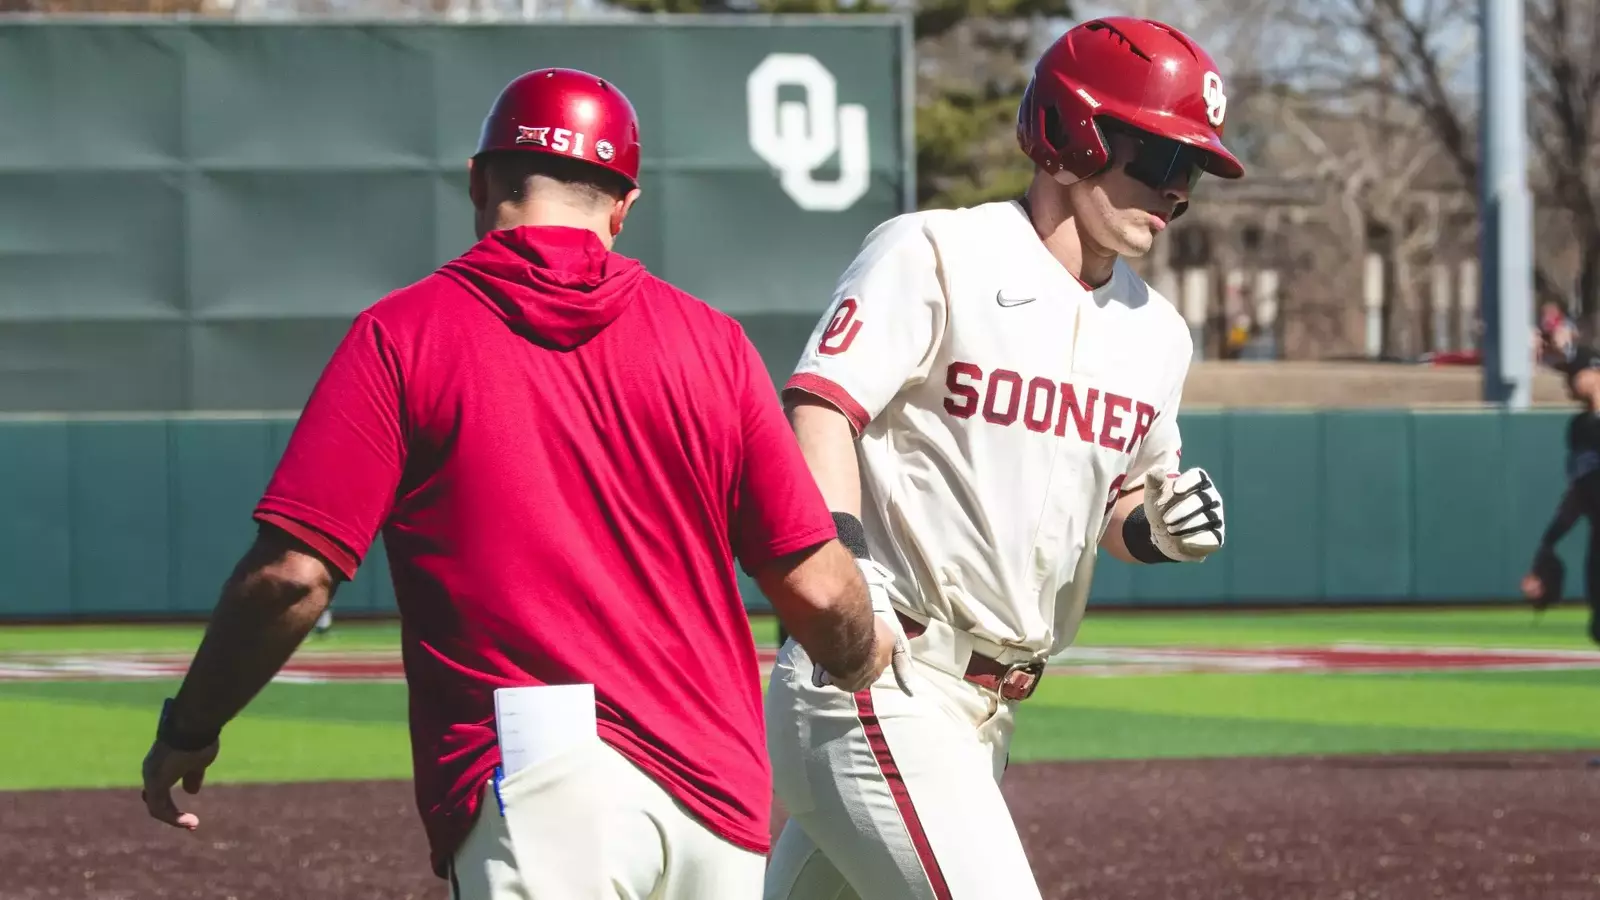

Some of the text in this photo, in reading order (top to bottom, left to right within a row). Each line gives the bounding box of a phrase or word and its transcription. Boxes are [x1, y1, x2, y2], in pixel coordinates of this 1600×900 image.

[1203, 70, 1228, 126] OU
[551, 128, 585, 158] 51
[746, 52, 871, 212] OU
[818, 298, 864, 356] OU
